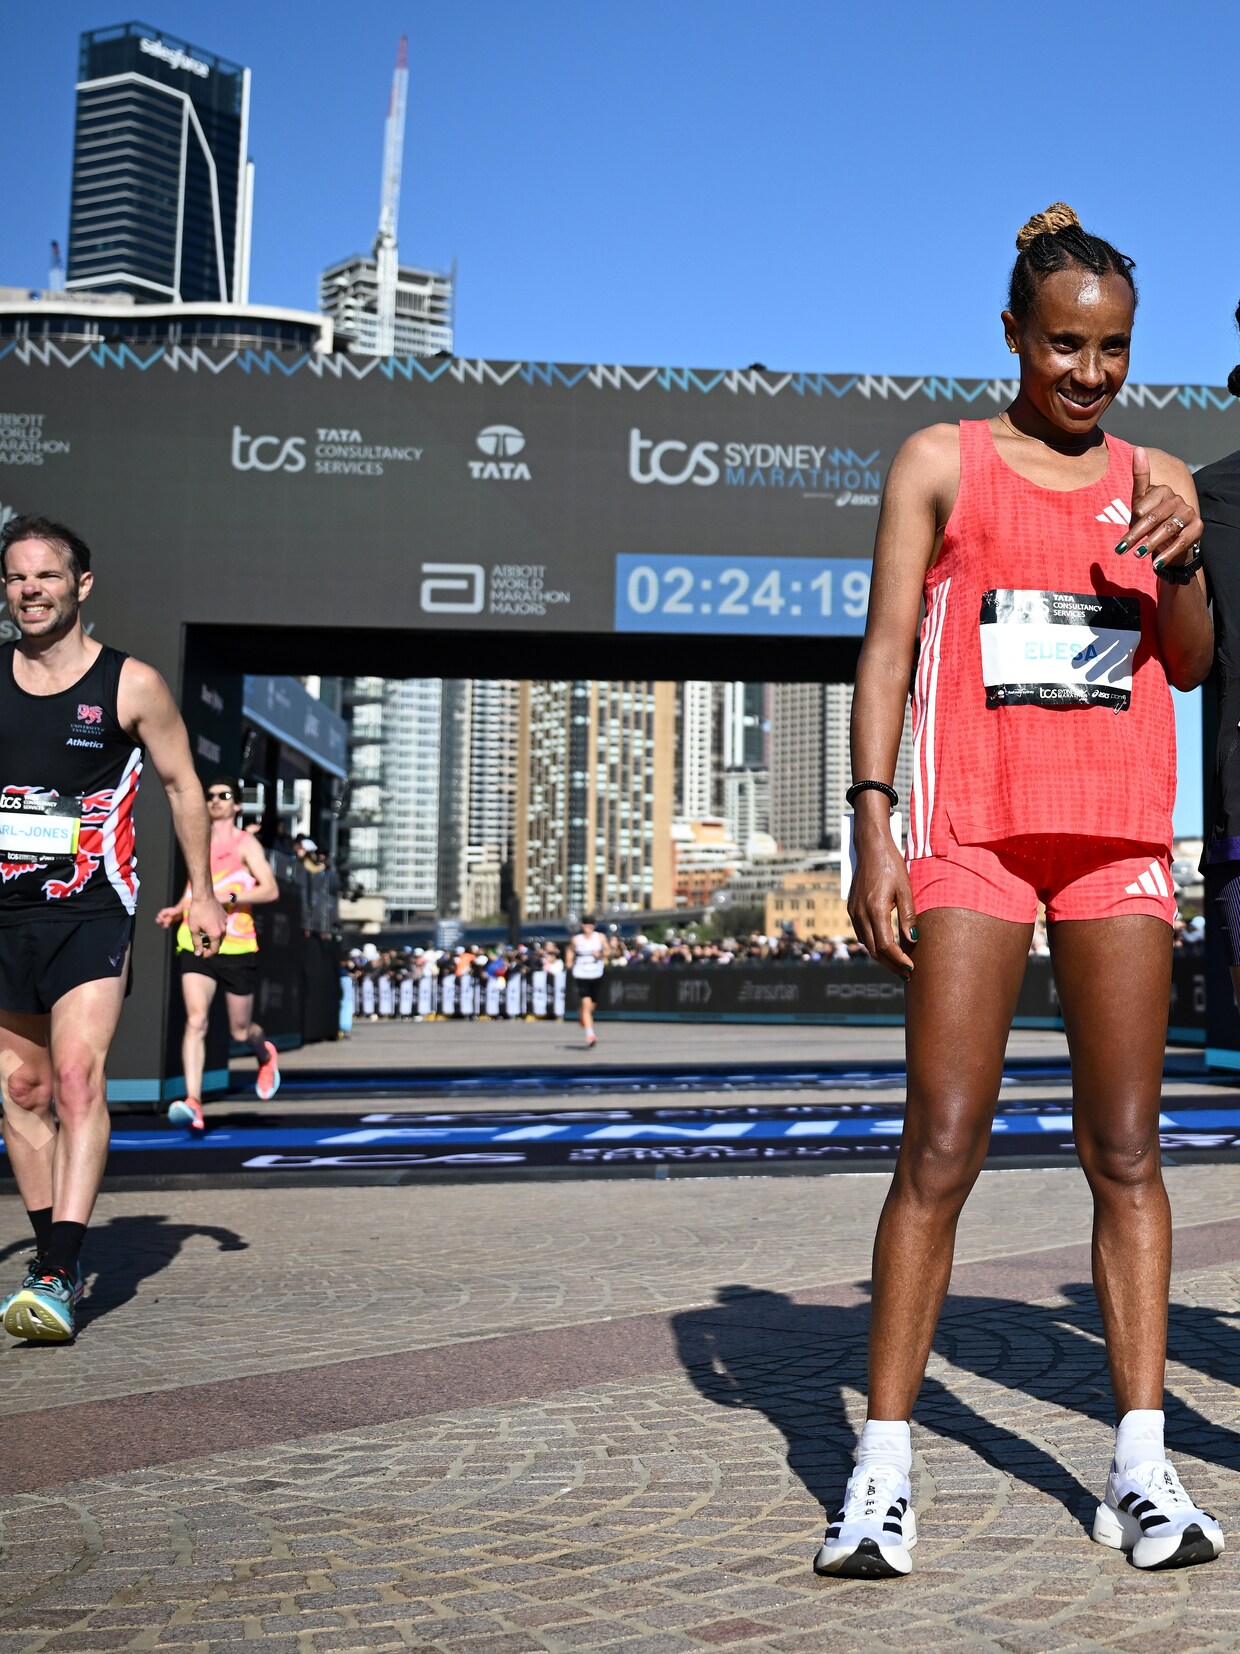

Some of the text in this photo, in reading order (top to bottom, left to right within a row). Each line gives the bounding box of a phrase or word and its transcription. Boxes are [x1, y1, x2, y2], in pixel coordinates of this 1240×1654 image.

[316, 428, 362, 442] TATA
[232, 425, 306, 472] tcs
[315, 444, 423, 461] CONSULTANCY
[724, 442, 826, 468] SYDNEY
[630, 428, 720, 486] tcs
[315, 460, 384, 475] SERVICES
[468, 461, 532, 480] TATA
[725, 467, 880, 489] MARATHON
[492, 564, 547, 578] ABBOTT
[491, 578, 544, 590] WORLD
[490, 590, 571, 604] MARATHON
[627, 566, 870, 617] 02:24:19
[1053, 595, 1075, 603] TATA
[490, 602, 547, 616] MAJORS
[1053, 602, 1103, 613] CONSULTANCY
[1053, 610, 1086, 619] SERVICES
[66, 737, 104, 749] Athletics
